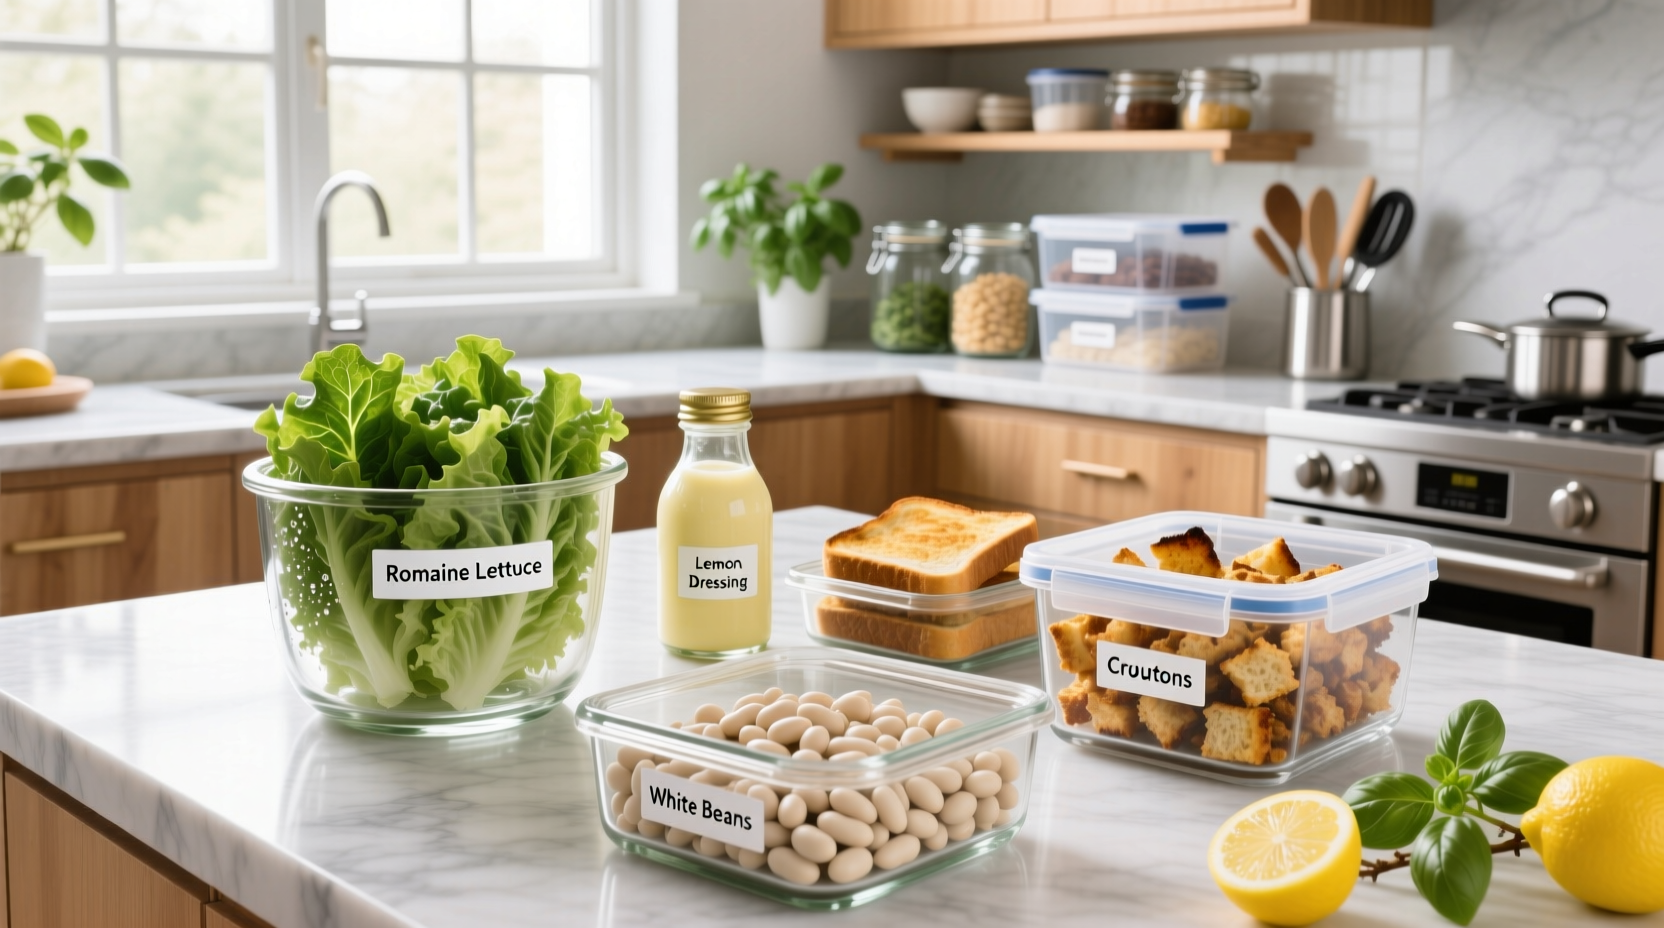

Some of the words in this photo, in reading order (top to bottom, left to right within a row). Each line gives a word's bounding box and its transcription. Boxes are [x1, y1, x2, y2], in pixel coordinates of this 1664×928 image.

[386, 563, 470, 583] Romaine
[476, 561, 542, 580] Lettuce
[695, 556, 743, 570] Lemon
[689, 574, 748, 592] Dressing
[649, 785, 697, 815] White
[702, 799, 753, 831] Beans
